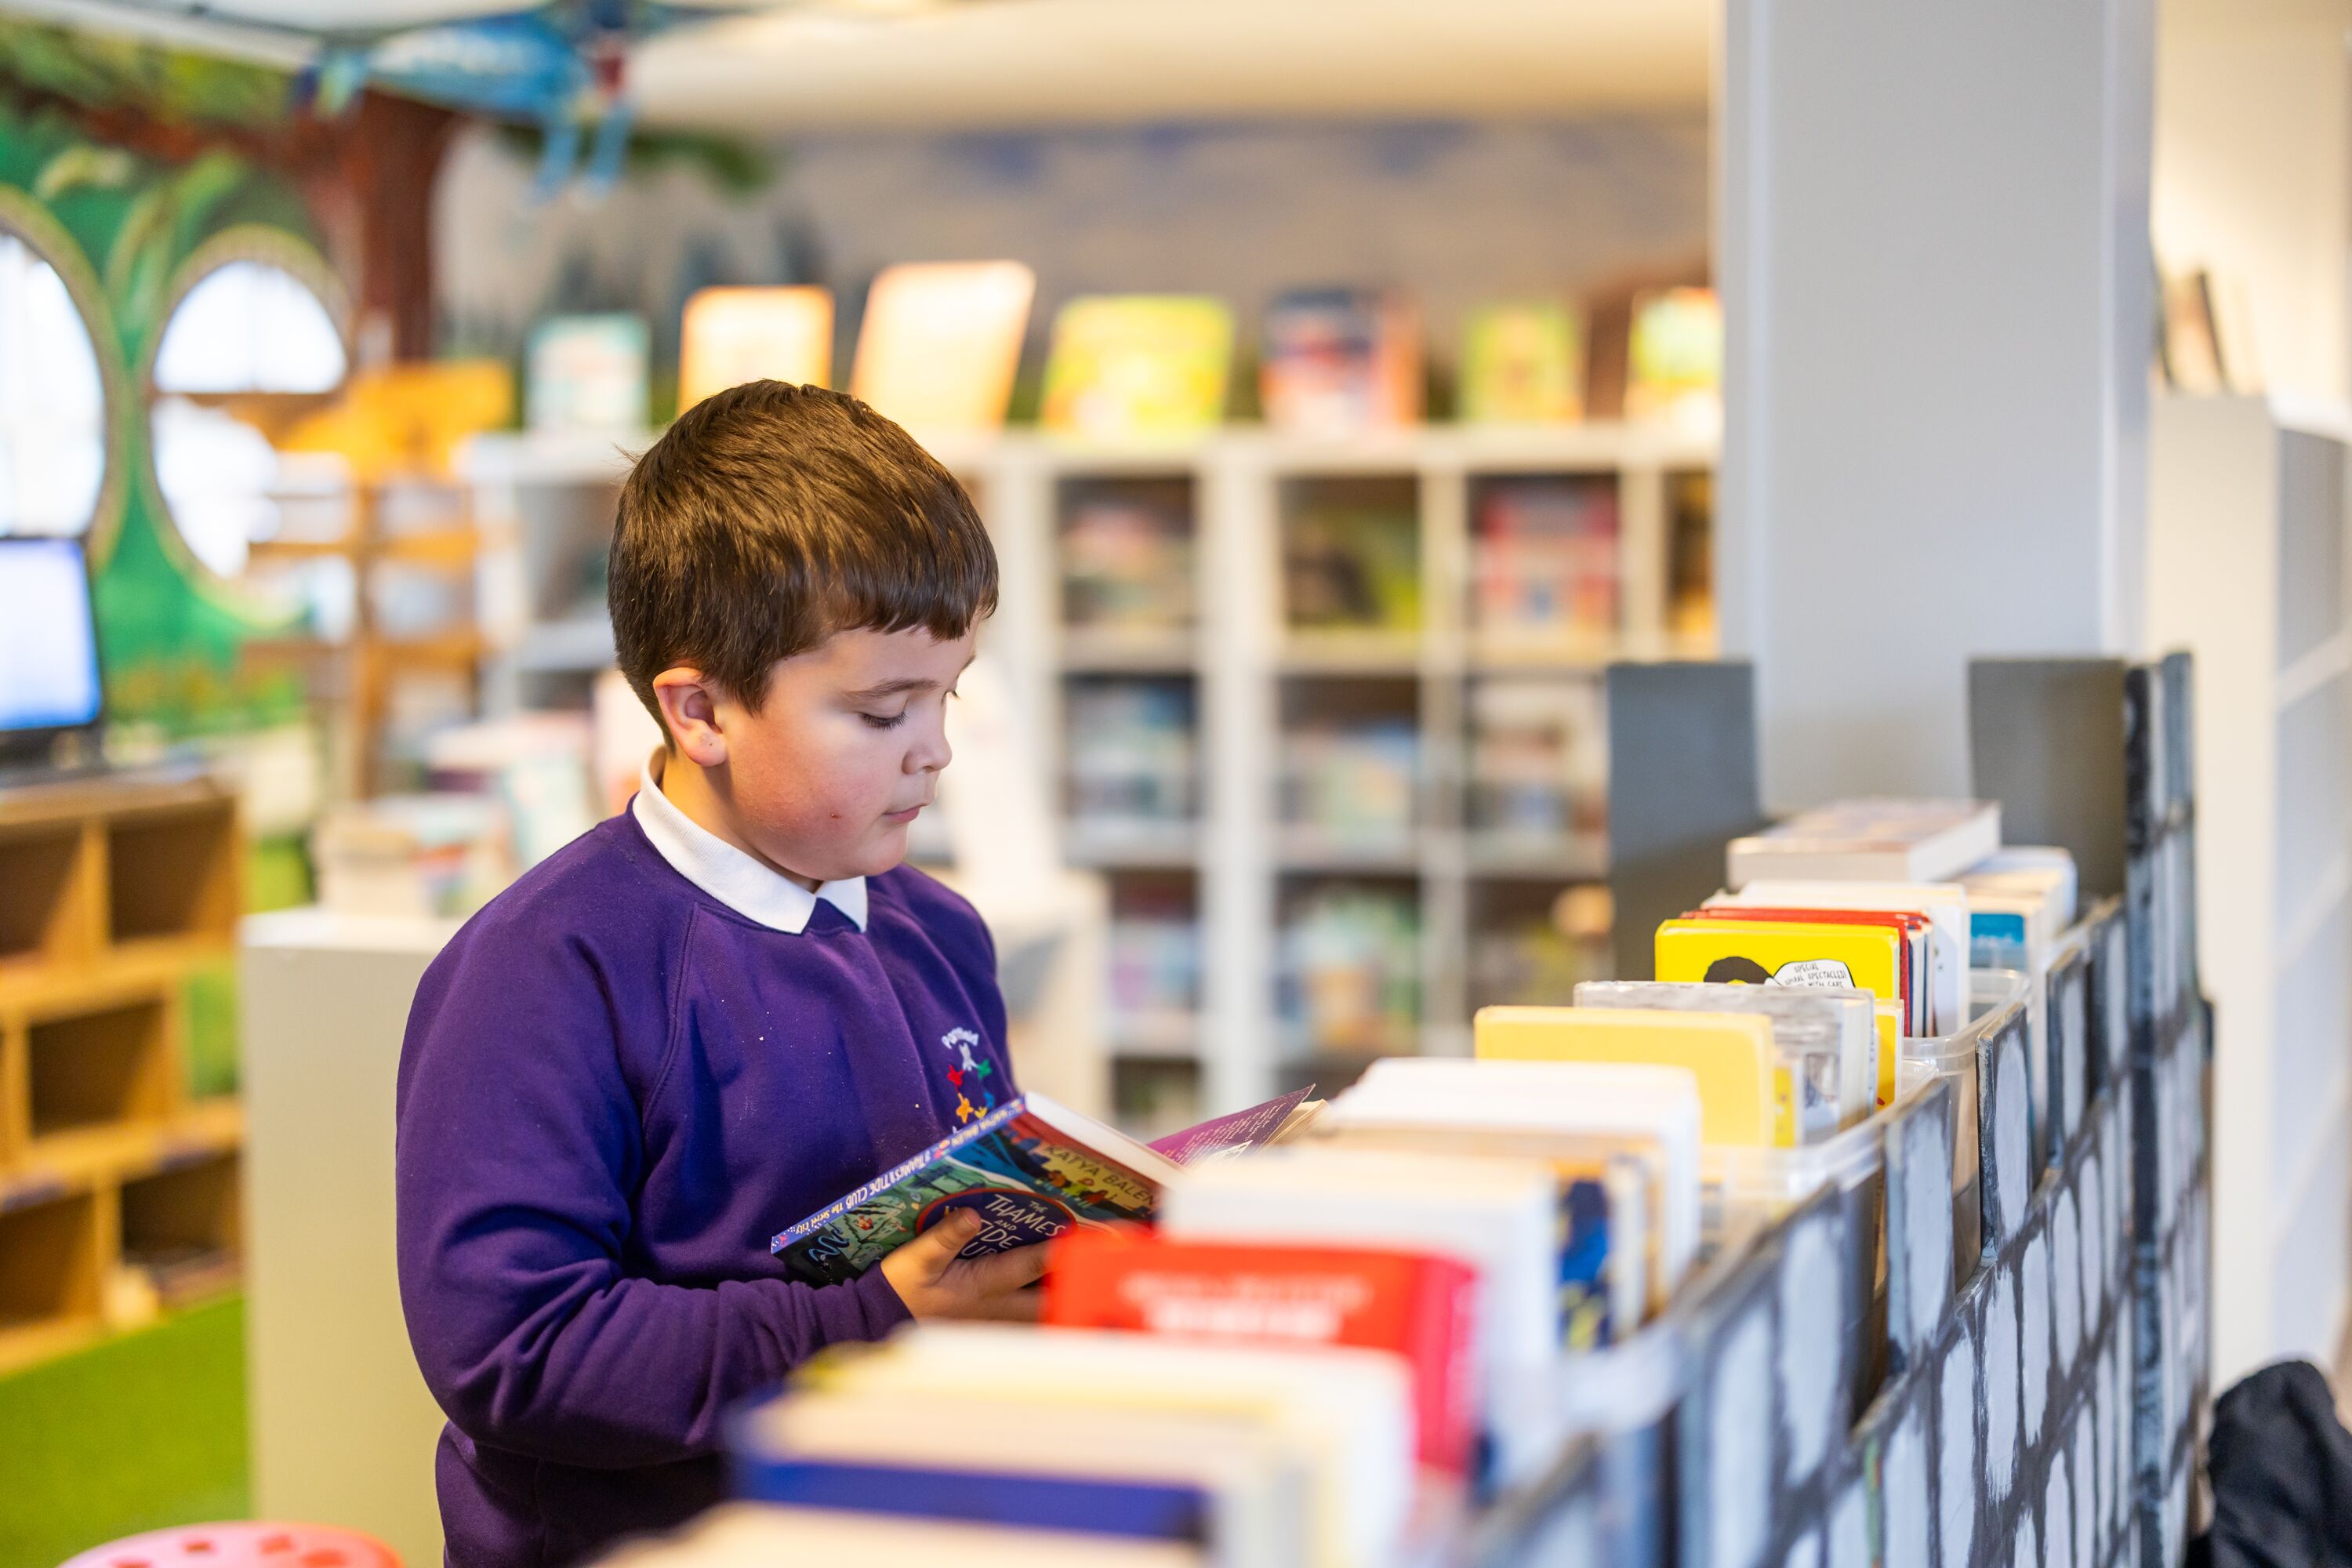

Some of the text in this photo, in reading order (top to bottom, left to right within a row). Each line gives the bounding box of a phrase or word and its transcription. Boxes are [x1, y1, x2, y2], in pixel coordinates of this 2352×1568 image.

[1045, 1144, 1099, 1176] KATYA
[870, 1177, 891, 1195] TIDE
[846, 1186, 868, 1209] CLUB
[1029, 1200, 1048, 1213] THE
[832, 1202, 844, 1214] The
[985, 1193, 1066, 1236] THAMES
[811, 1210, 830, 1227] Secret
[994, 1219, 1017, 1231] AND
[977, 1218, 1023, 1249] IDE
